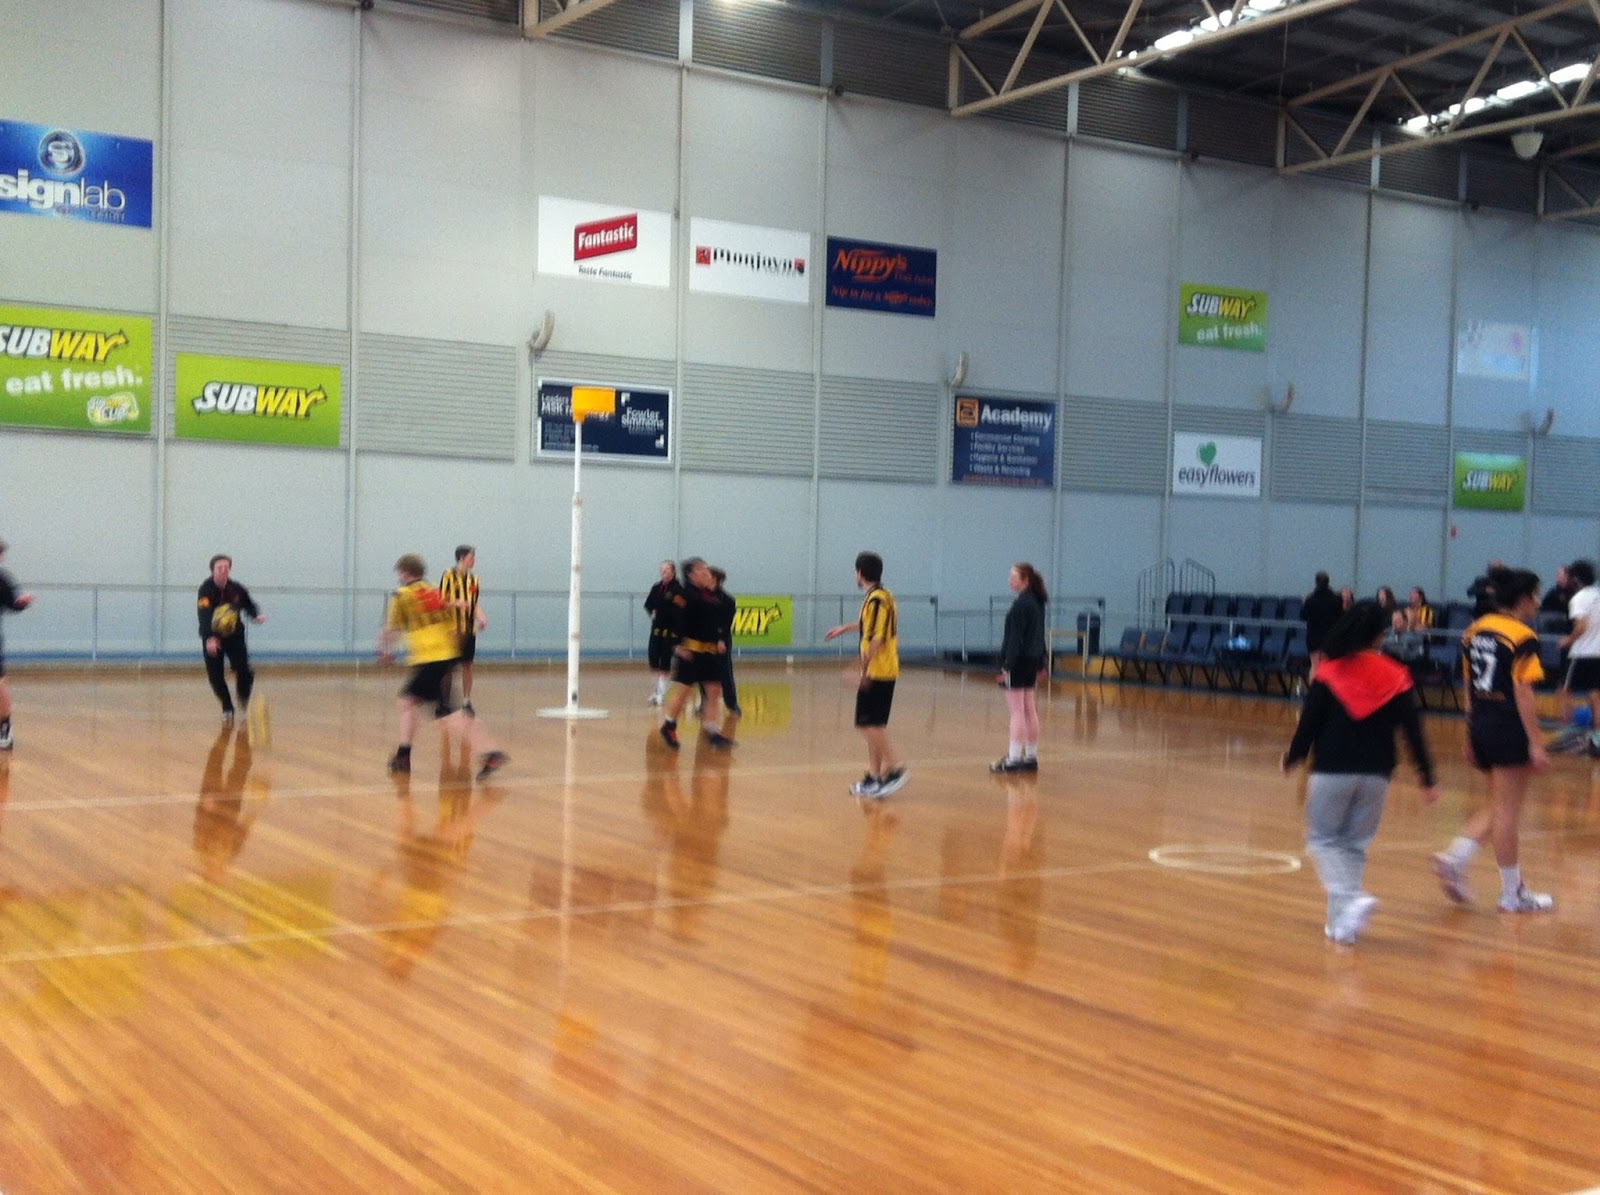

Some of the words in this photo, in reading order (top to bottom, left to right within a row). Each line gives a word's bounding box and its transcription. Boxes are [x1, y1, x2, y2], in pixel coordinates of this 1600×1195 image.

[0, 168, 126, 211] signlab
[578, 222, 635, 251] Fantastic
[578, 265, 597, 277] Taste
[598, 266, 633, 279] Fantastic
[1186, 292, 1257, 320] SUBWAY
[1196, 325, 1219, 342] eat
[6, 370, 53, 396] eat
[192, 380, 328, 418] SUBWAY
[626, 406, 660, 421] Fowler
[981, 403, 1052, 433] Academy
[1178, 463, 1256, 488] easyflowers
[1461, 470, 1519, 493] SUBWAY
[730, 602, 783, 636] WAY
